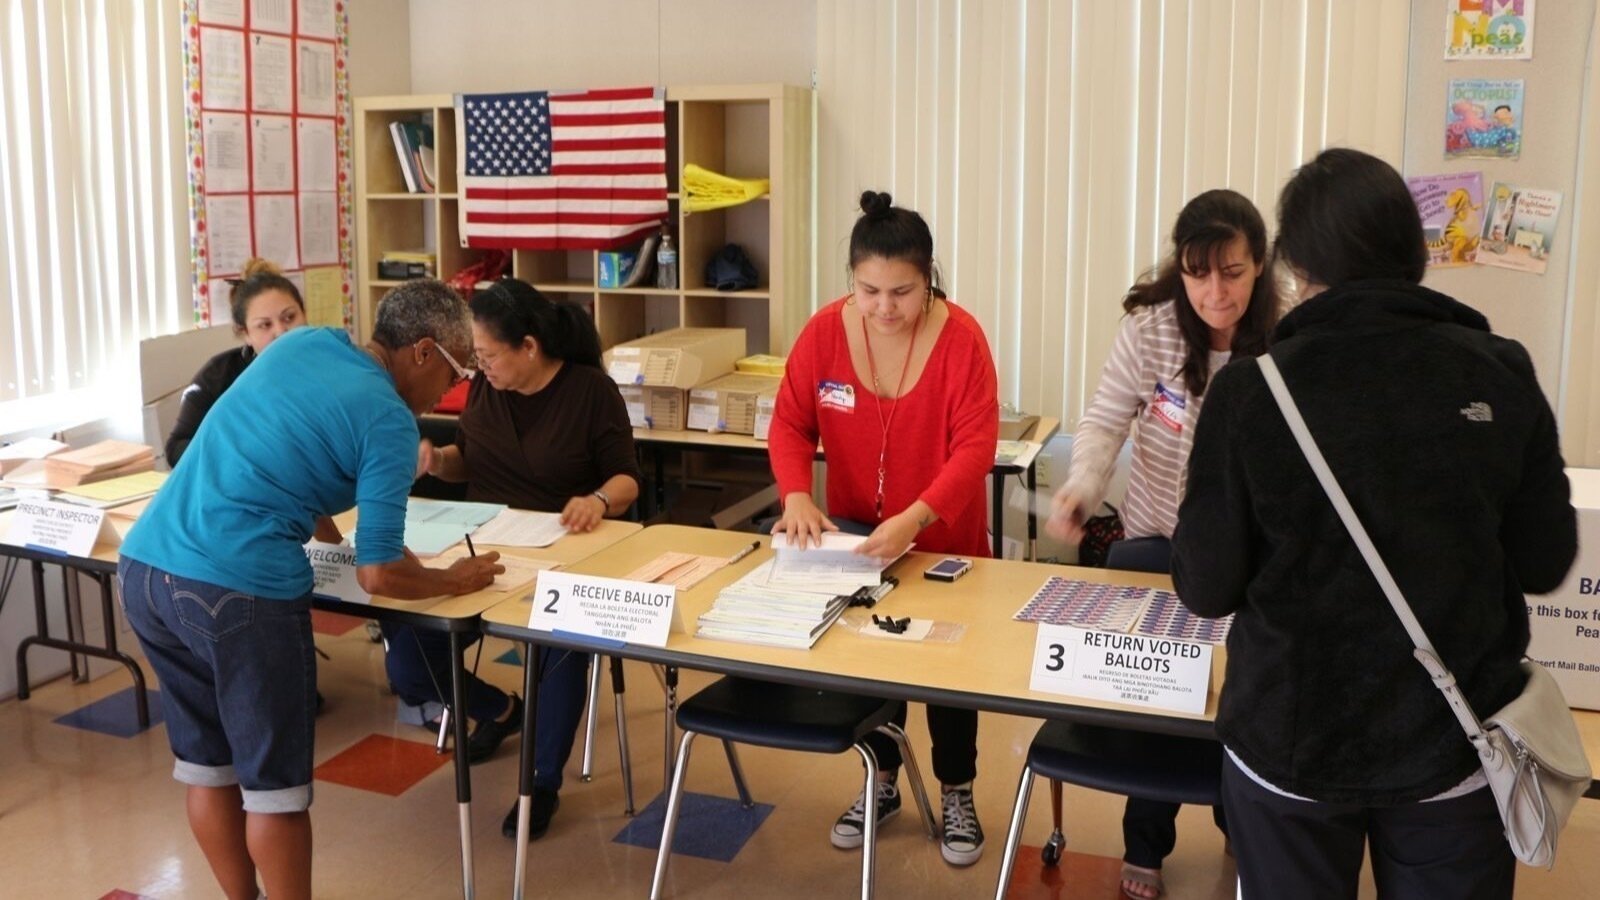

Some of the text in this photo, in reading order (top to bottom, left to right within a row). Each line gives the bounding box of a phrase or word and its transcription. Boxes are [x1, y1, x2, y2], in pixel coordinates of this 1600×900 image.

[1471, 32, 1524, 48] peas
[18, 503, 56, 517] PRECINCT
[56, 508, 100, 524] INSPECTOR
[544, 589, 560, 614] 2
[572, 584, 672, 608] RECEIVE BALLOT
[1537, 605, 1560, 617] this
[1564, 607, 1588, 620] box
[1084, 632, 1201, 659] RETURN VOTED
[1046, 643, 1065, 672] 3
[1105, 652, 1171, 674] BALLOTS
[1558, 661, 1576, 670] Mail
